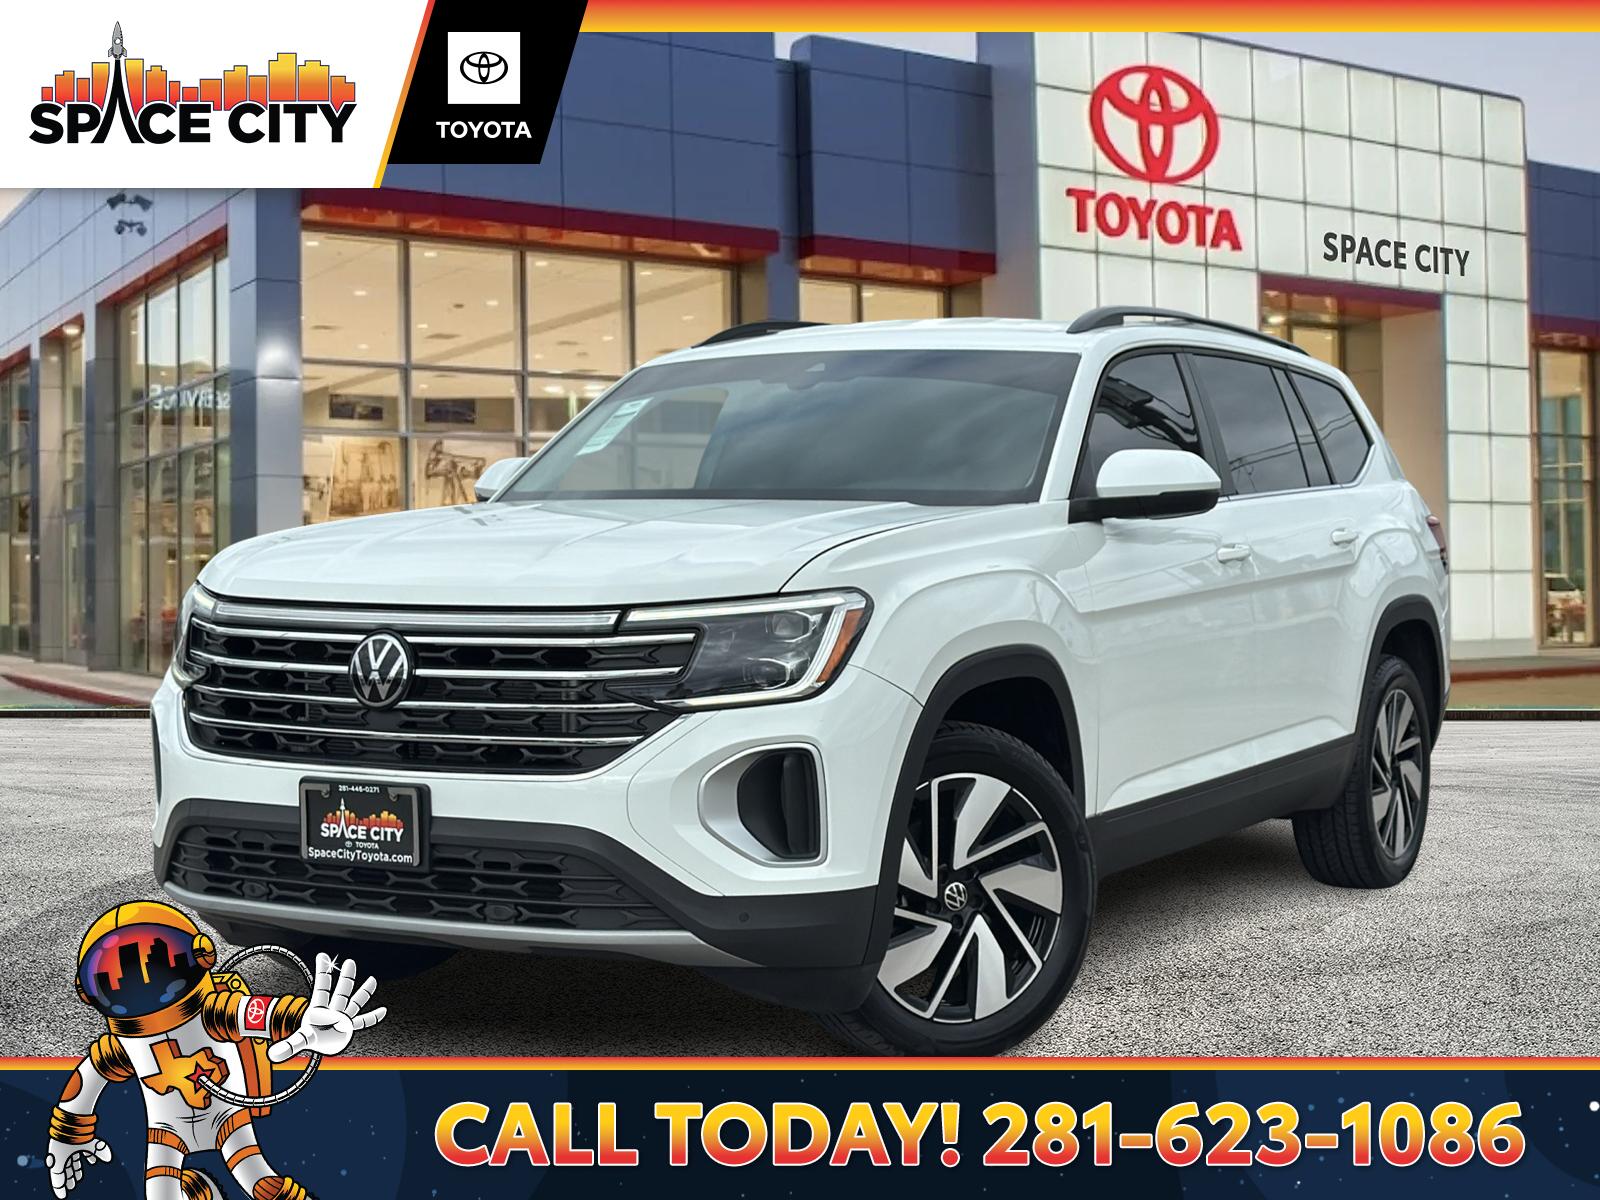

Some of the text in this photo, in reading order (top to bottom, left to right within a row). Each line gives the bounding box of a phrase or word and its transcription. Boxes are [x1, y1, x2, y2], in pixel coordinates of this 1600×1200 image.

[1066, 187, 1242, 251] TOYOTA
[1323, 231, 1470, 277] SPACE CITY
[320, 810, 404, 842] SPACE CITY
[308, 846, 413, 864] SpaceCityToyota.com
[355, 841, 379, 849] TOYOTA
